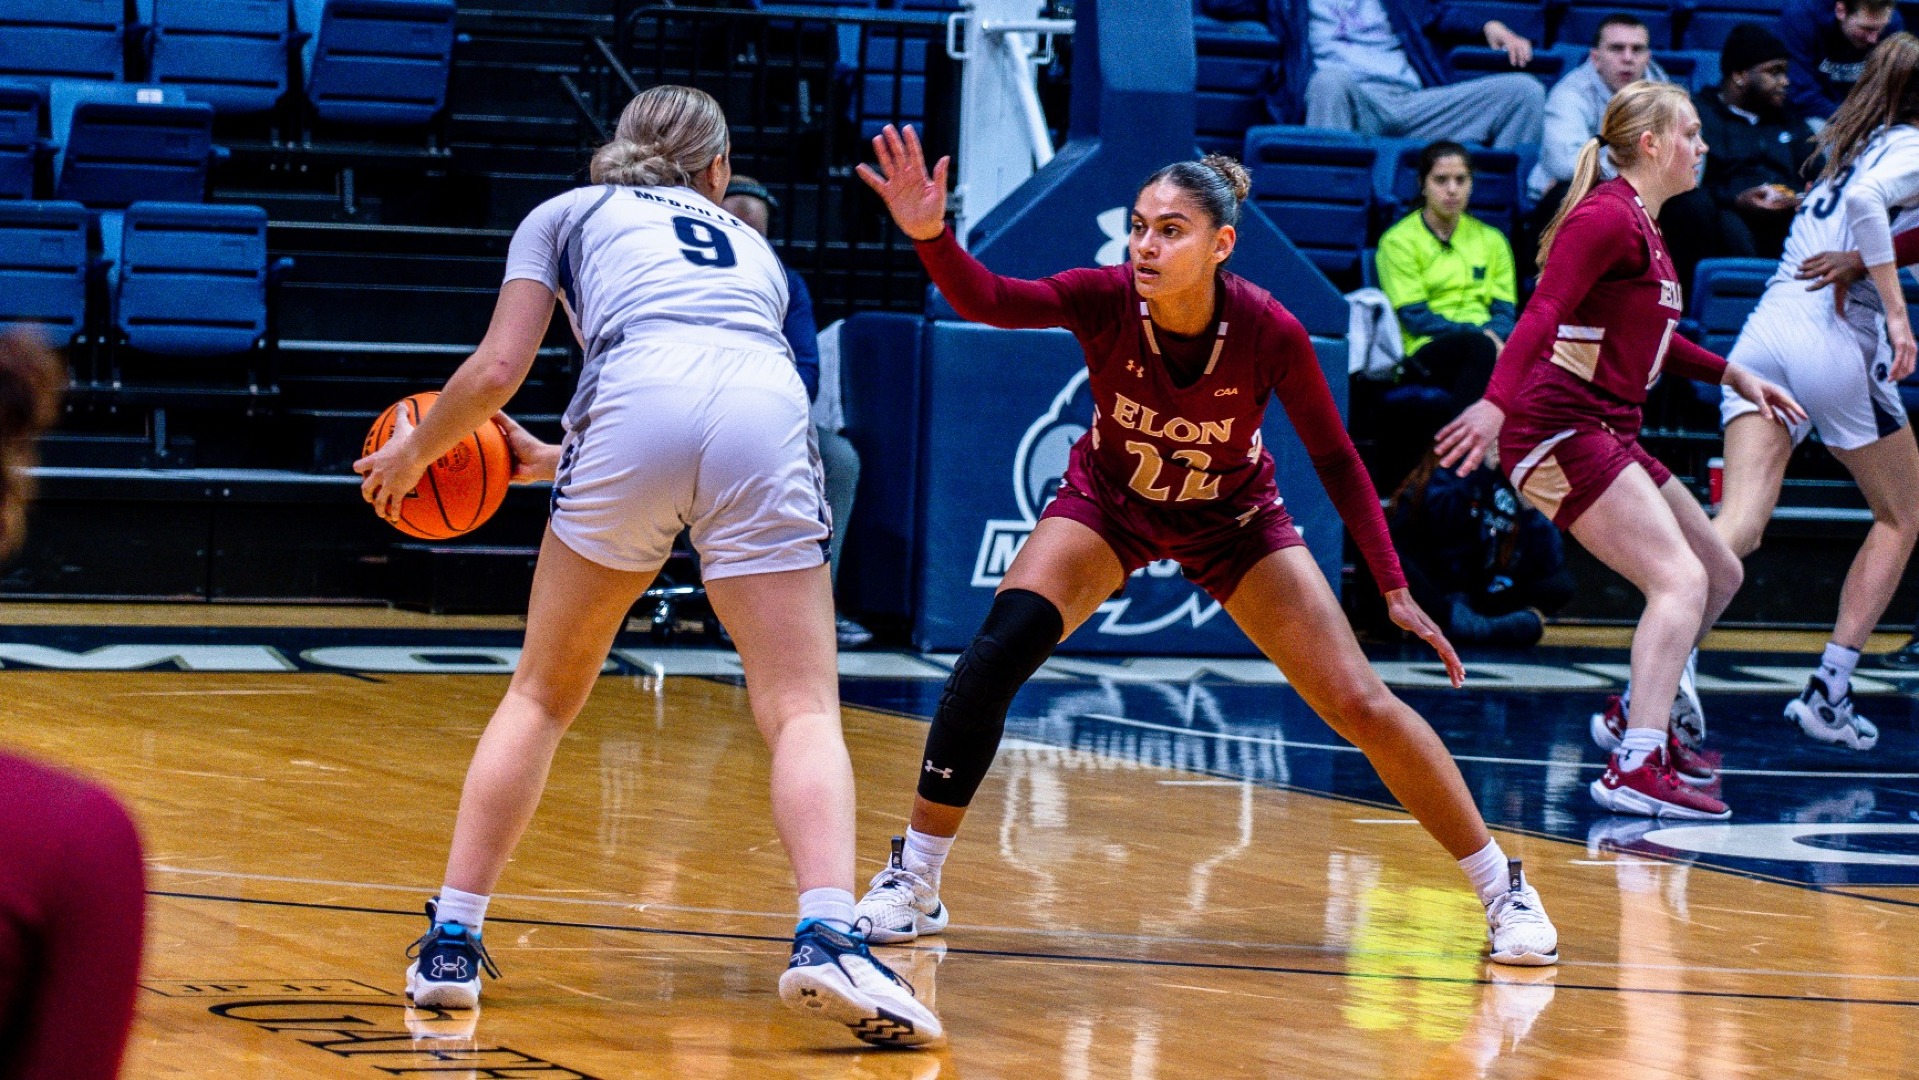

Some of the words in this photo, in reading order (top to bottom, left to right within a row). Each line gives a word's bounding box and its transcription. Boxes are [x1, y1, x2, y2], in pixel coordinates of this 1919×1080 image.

[671, 214, 738, 269] 9
[1110, 391, 1236, 445] ELON
[1213, 387, 1239, 398] CAA
[1124, 439, 1223, 502] 22
